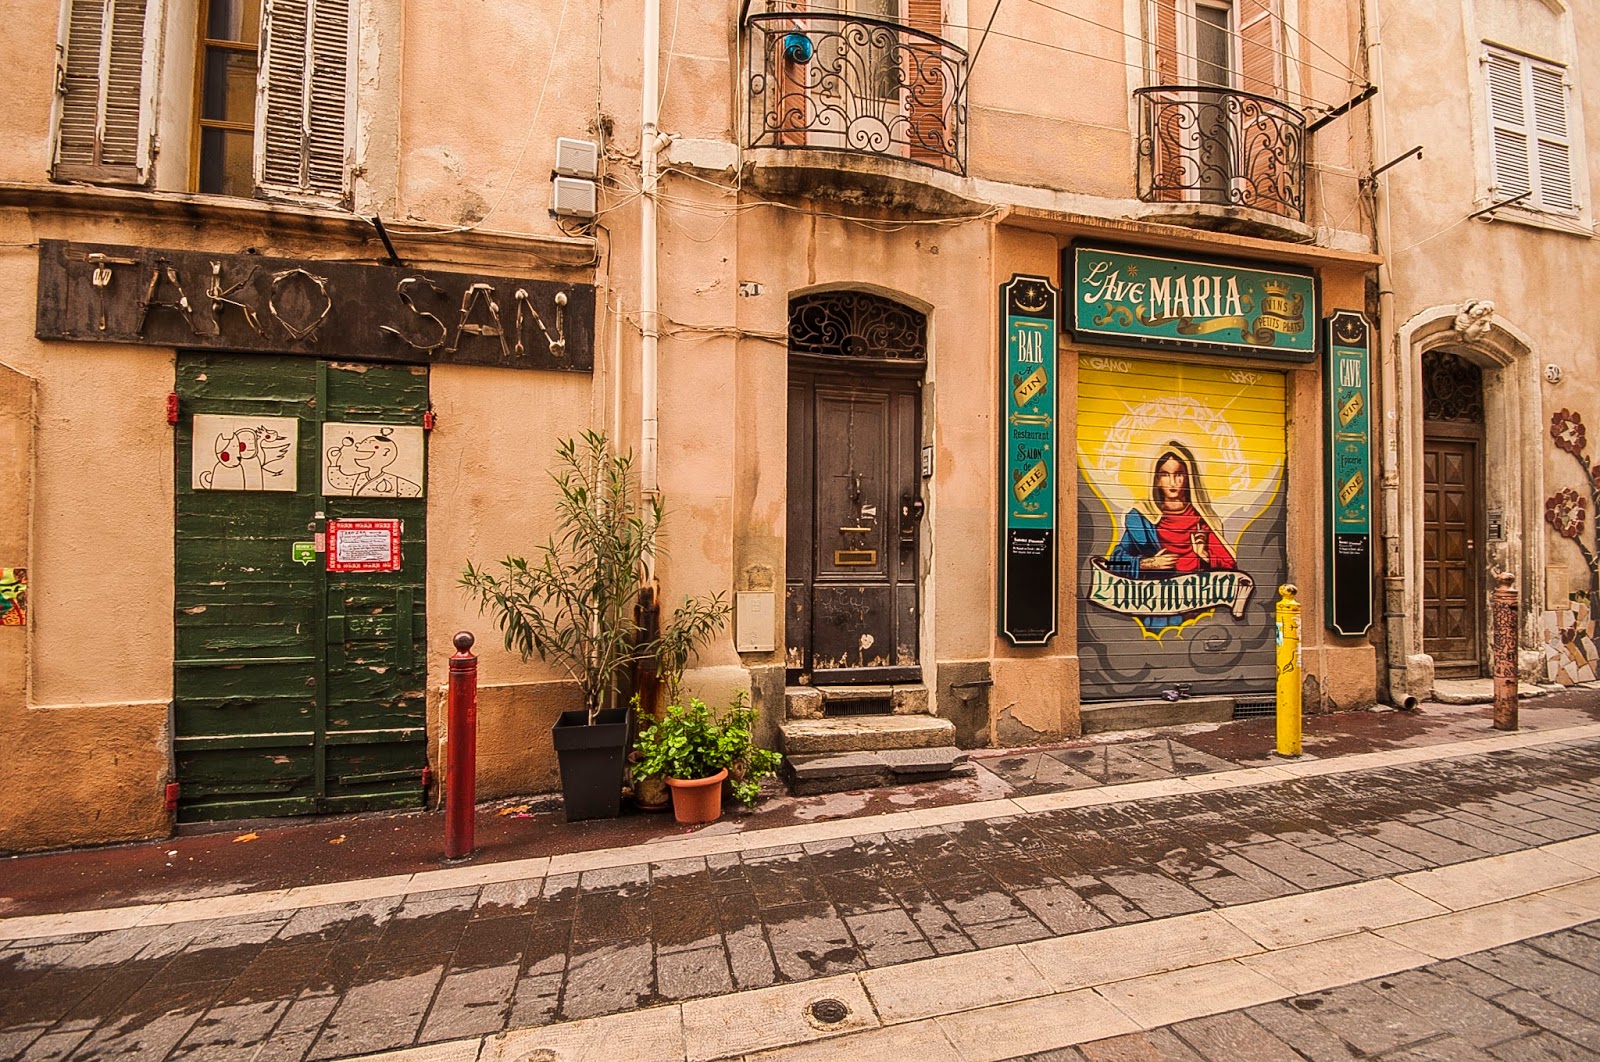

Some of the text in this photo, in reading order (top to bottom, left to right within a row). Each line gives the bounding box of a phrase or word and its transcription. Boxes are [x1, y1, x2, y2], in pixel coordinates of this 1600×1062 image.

[65, 252, 568, 357] TAKO SAN
[1149, 275, 1245, 322] MARIA
[1267, 299, 1288, 312] VINS
[1258, 317, 1302, 333] PETITS PLATS
[1018, 329, 1044, 363] BAR
[1141, 337, 1257, 353] MASSILIA
[1340, 358, 1362, 388] CAVE
[1019, 377, 1041, 396] VIN
[1343, 400, 1360, 417] VIN
[1013, 429, 1050, 440] Restaurant
[1023, 463, 1032, 472] de
[1341, 476, 1362, 501] FINE
